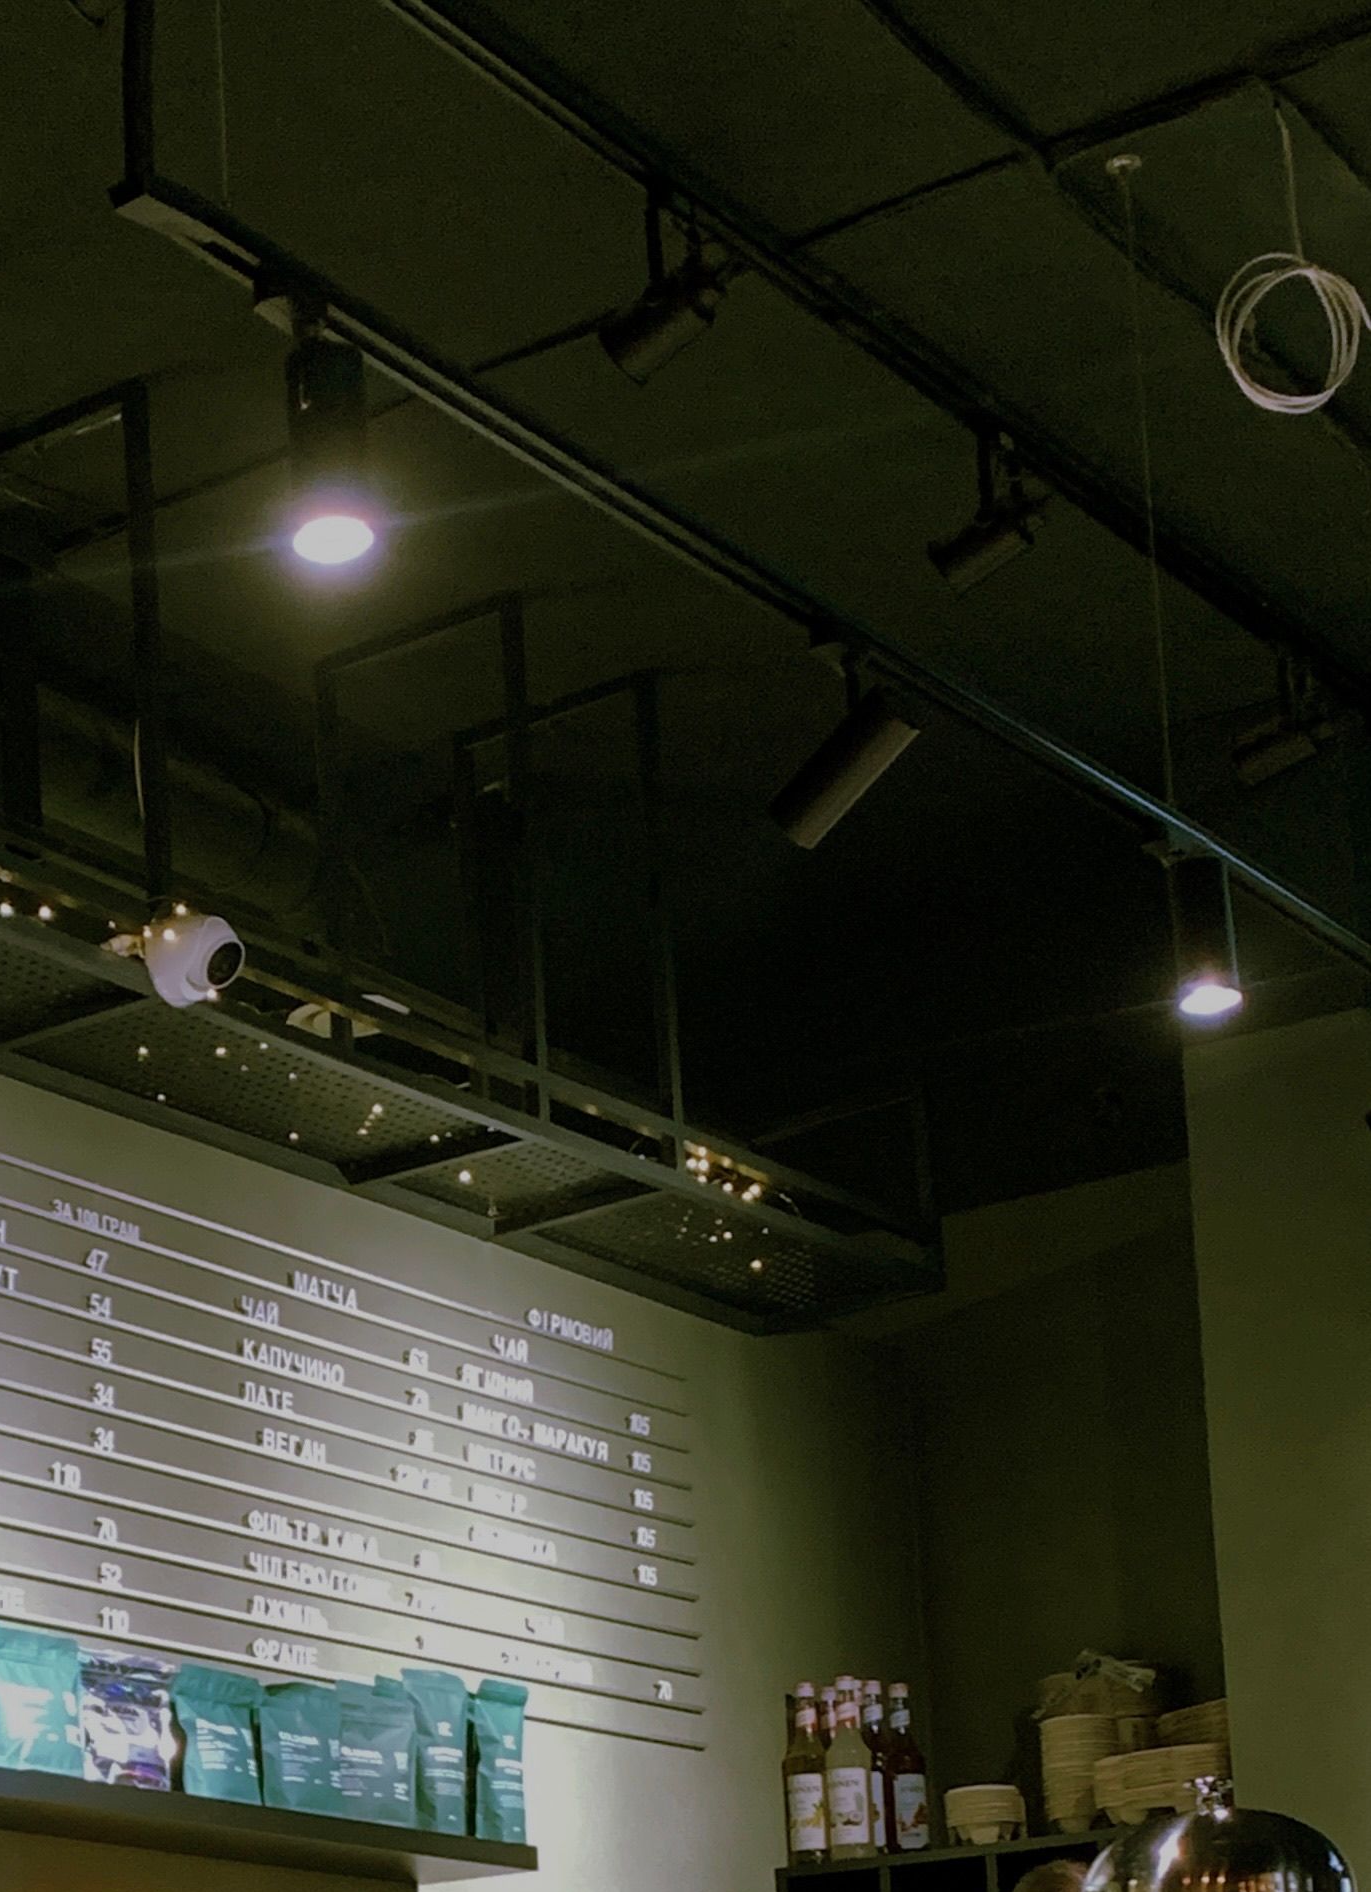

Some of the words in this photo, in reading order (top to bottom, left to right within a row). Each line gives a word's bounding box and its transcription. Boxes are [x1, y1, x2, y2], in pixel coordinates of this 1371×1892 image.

[86, 1248, 109, 1275] 47
[294, 1271, 359, 1311] МАТЧА
[90, 1294, 112, 1320] 54
[241, 1296, 280, 1327] ЧАЙ
[529, 1308, 613, 1350] ФІРМОВИЙ
[92, 1338, 113, 1365] 55
[243, 1338, 345, 1388] КАПУЧИНО
[494, 1334, 528, 1363] ЧАЙ
[94, 1383, 115, 1409] 34
[245, 1382, 294, 1414] ЛАТЕ
[94, 1427, 115, 1452] 34
[262, 1428, 327, 1465] ВЕГАН
